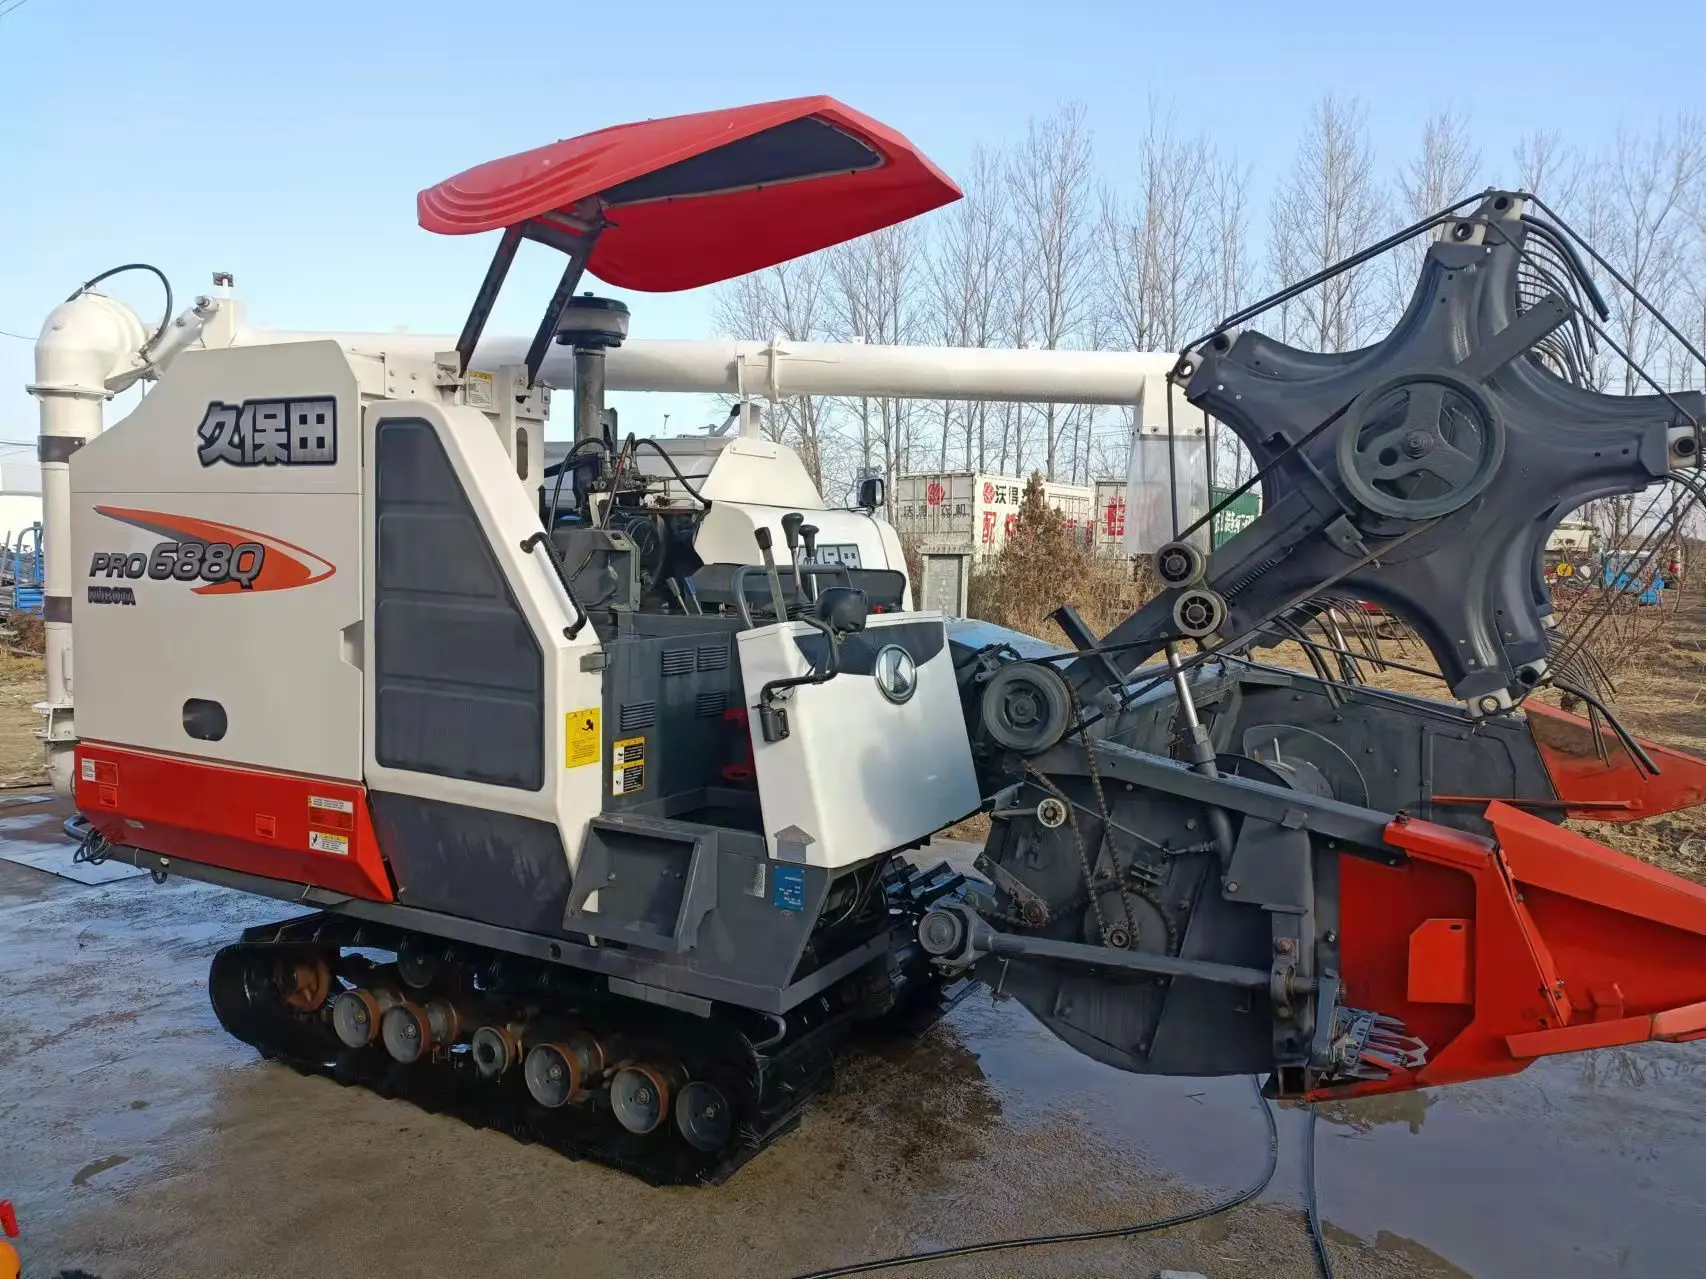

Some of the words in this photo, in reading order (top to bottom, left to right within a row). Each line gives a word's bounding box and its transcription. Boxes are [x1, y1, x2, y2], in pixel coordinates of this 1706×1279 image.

[197, 395, 338, 467] 久保田
[87, 585, 137, 606] KUBOTA
